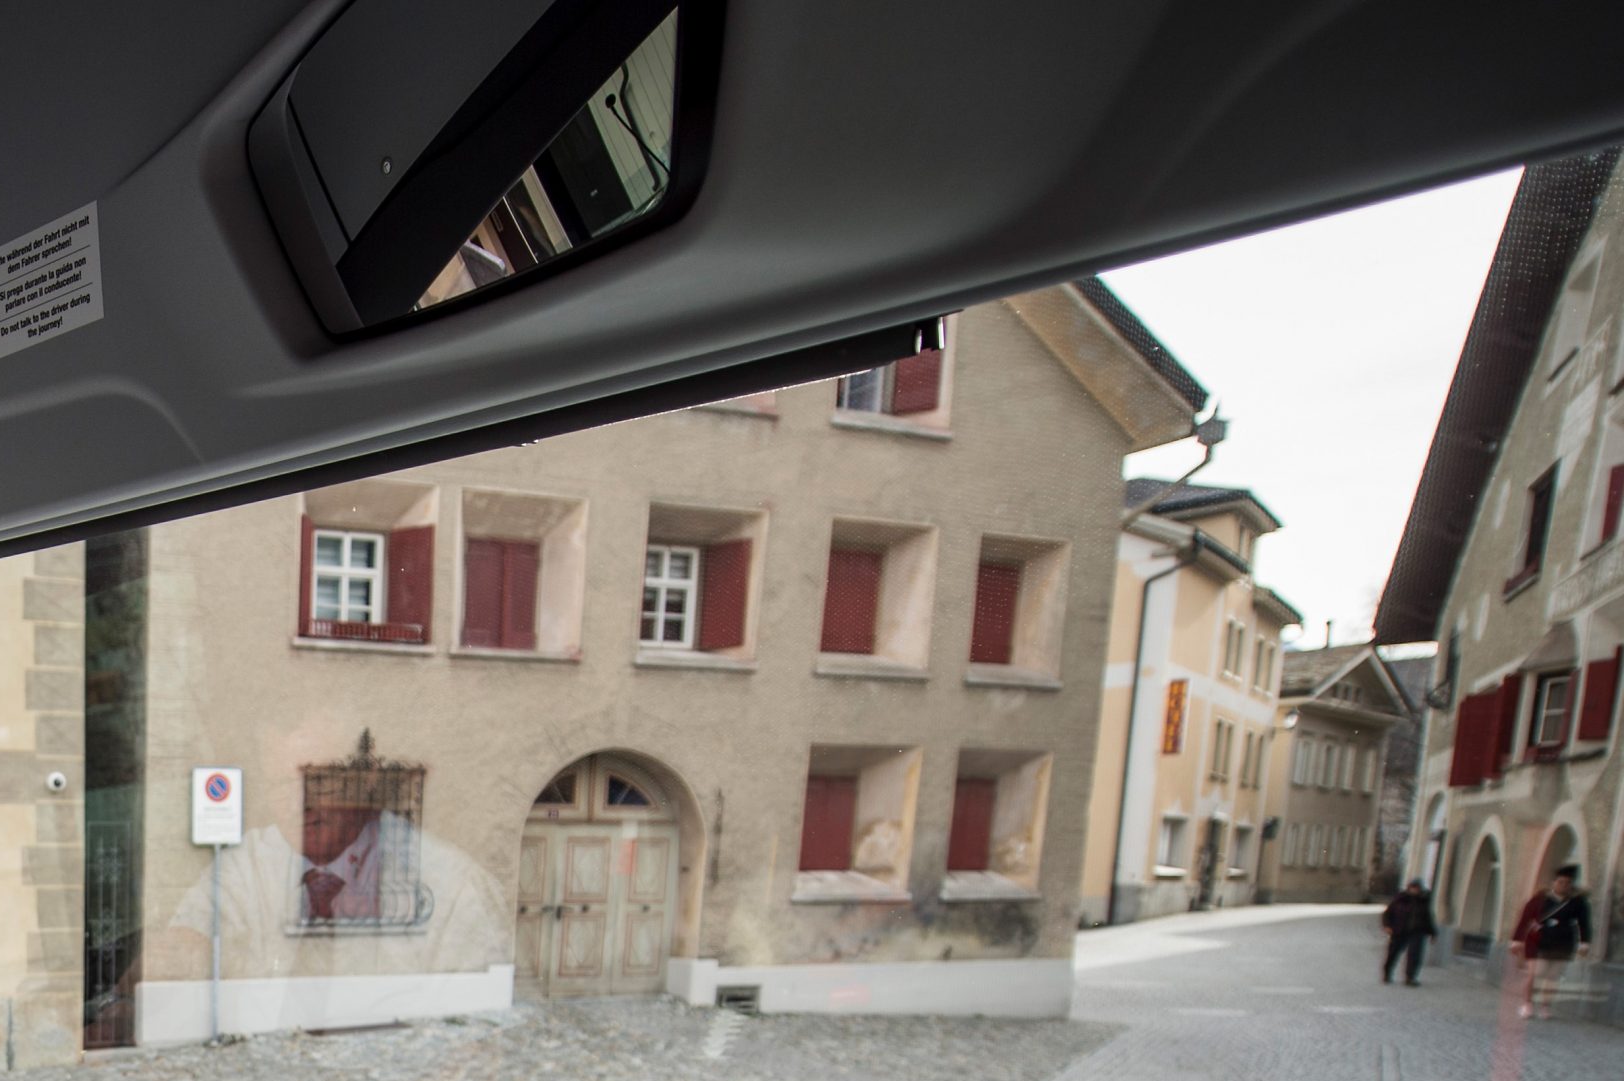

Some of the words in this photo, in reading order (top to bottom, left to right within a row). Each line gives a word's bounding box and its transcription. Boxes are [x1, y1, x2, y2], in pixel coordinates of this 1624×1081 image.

[6, 242, 32, 261] während
[33, 238, 43, 249] der
[44, 229, 60, 244] Fahrt
[61, 221, 77, 236] nicht
[78, 215, 89, 228] mit
[8, 262, 20, 273] dem
[21, 253, 40, 267] Fahrer
[42, 236, 71, 258] sprechen!
[0, 291, 5, 300] Si
[7, 285, 23, 299] prega
[24, 274, 47, 290] durante
[48, 271, 54, 279] la
[56, 262, 73, 278] guida
[74, 257, 86, 268] non
[5, 296, 25, 312] parlare
[27, 291, 37, 302] con
[39, 287, 43, 296] il
[44, 270, 81, 294] conducente!
[1, 327, 8, 336] Do
[10, 321, 19, 332] not
[20, 317, 31, 328] talk
[33, 315, 39, 323] to
[40, 310, 49, 320] the
[51, 302, 68, 315] driver
[70, 294, 90, 308] during
[28, 328, 37, 337] the
[38, 316, 62, 335] journey!
